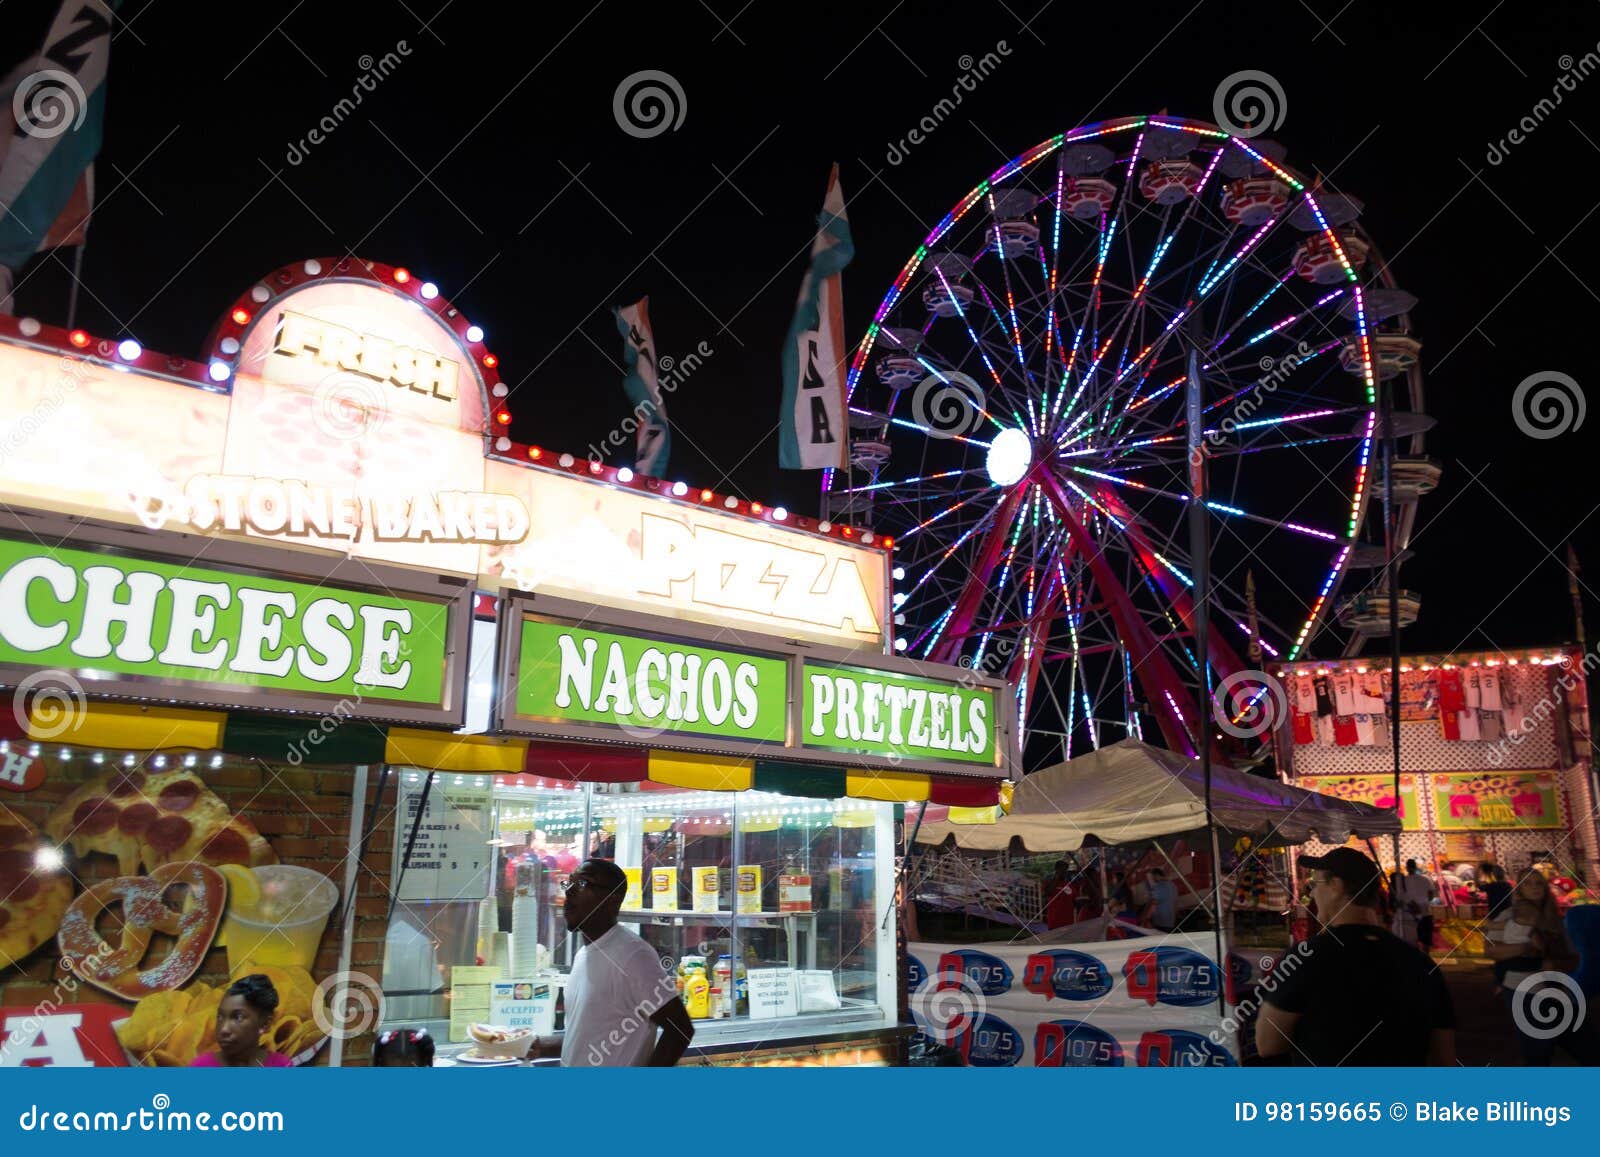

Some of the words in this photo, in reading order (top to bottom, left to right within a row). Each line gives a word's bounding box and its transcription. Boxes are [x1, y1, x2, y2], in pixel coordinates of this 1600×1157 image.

[273, 310, 459, 402] FRESH
[184, 473, 362, 542] STONE
[372, 489, 530, 545] BAKED
[637, 512, 881, 635] PIZZA
[0, 555, 414, 690] CHEESE
[555, 634, 760, 729] NACHOS
[809, 673, 988, 754] PRETZELS
[501, 1005, 544, 1014] ACCEPTED
[1126, 951, 1158, 1007] Q
[1159, 965, 1211, 985] 107.5
[510, 1017, 533, 1026] HERE
